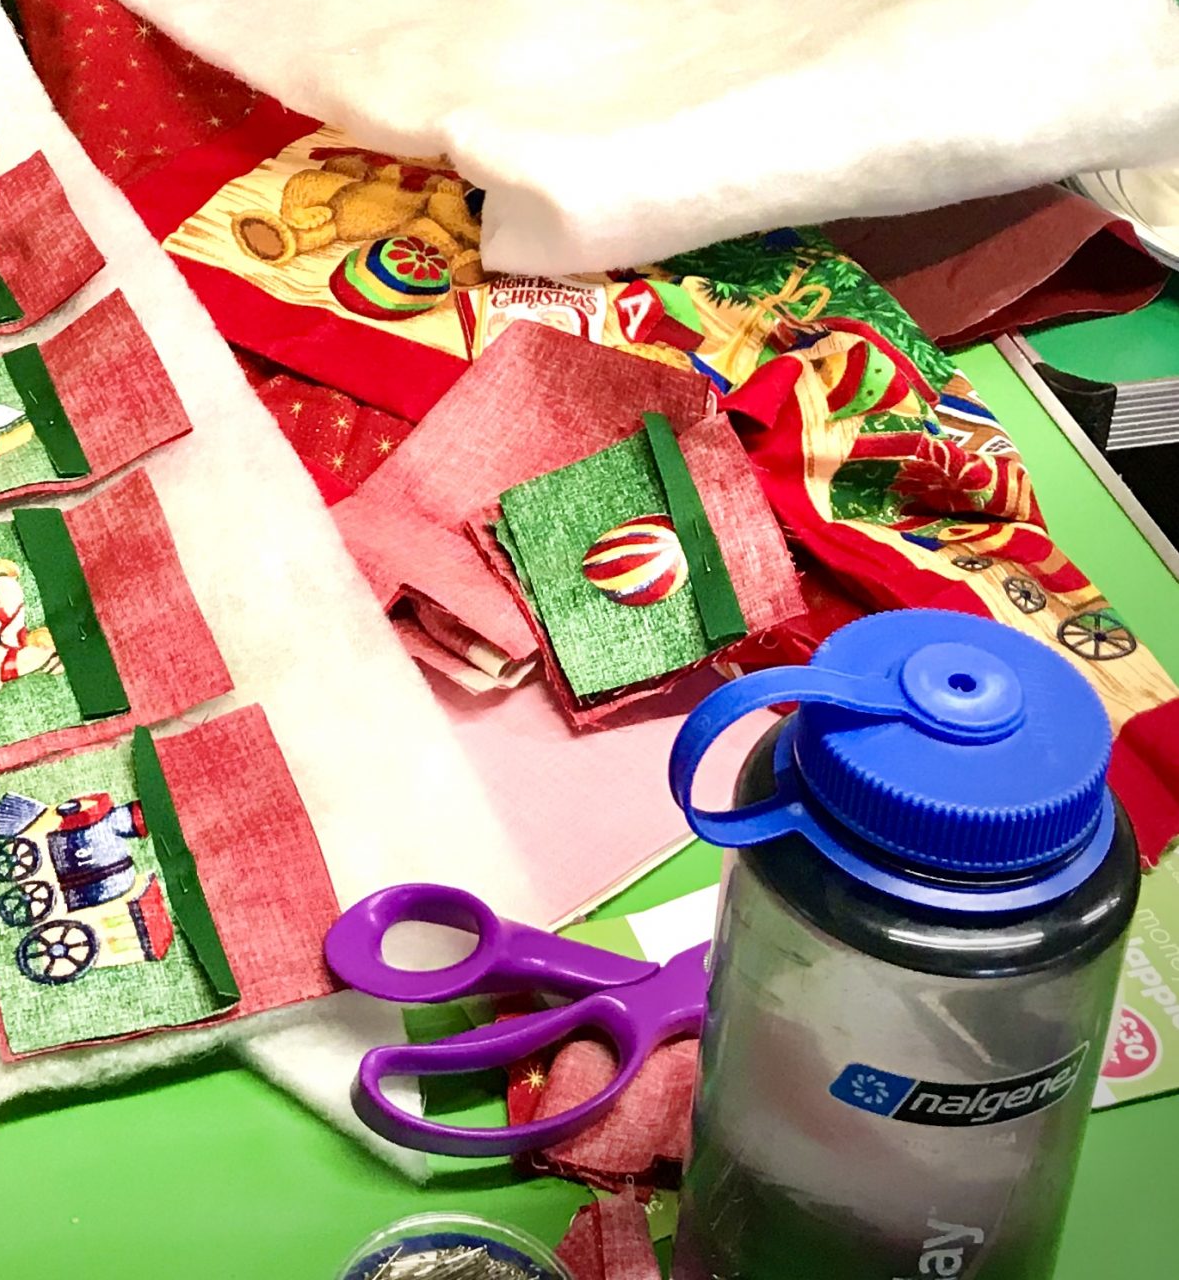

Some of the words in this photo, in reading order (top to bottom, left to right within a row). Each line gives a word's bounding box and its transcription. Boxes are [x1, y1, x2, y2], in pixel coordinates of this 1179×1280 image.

[488, 277, 536, 295] NIGHT
[491, 289, 598, 315] CHRISTMAS
[618, 290, 655, 341] A
[909, 1066, 1074, 1123] nalgene
[915, 1218, 984, 1280] ay
